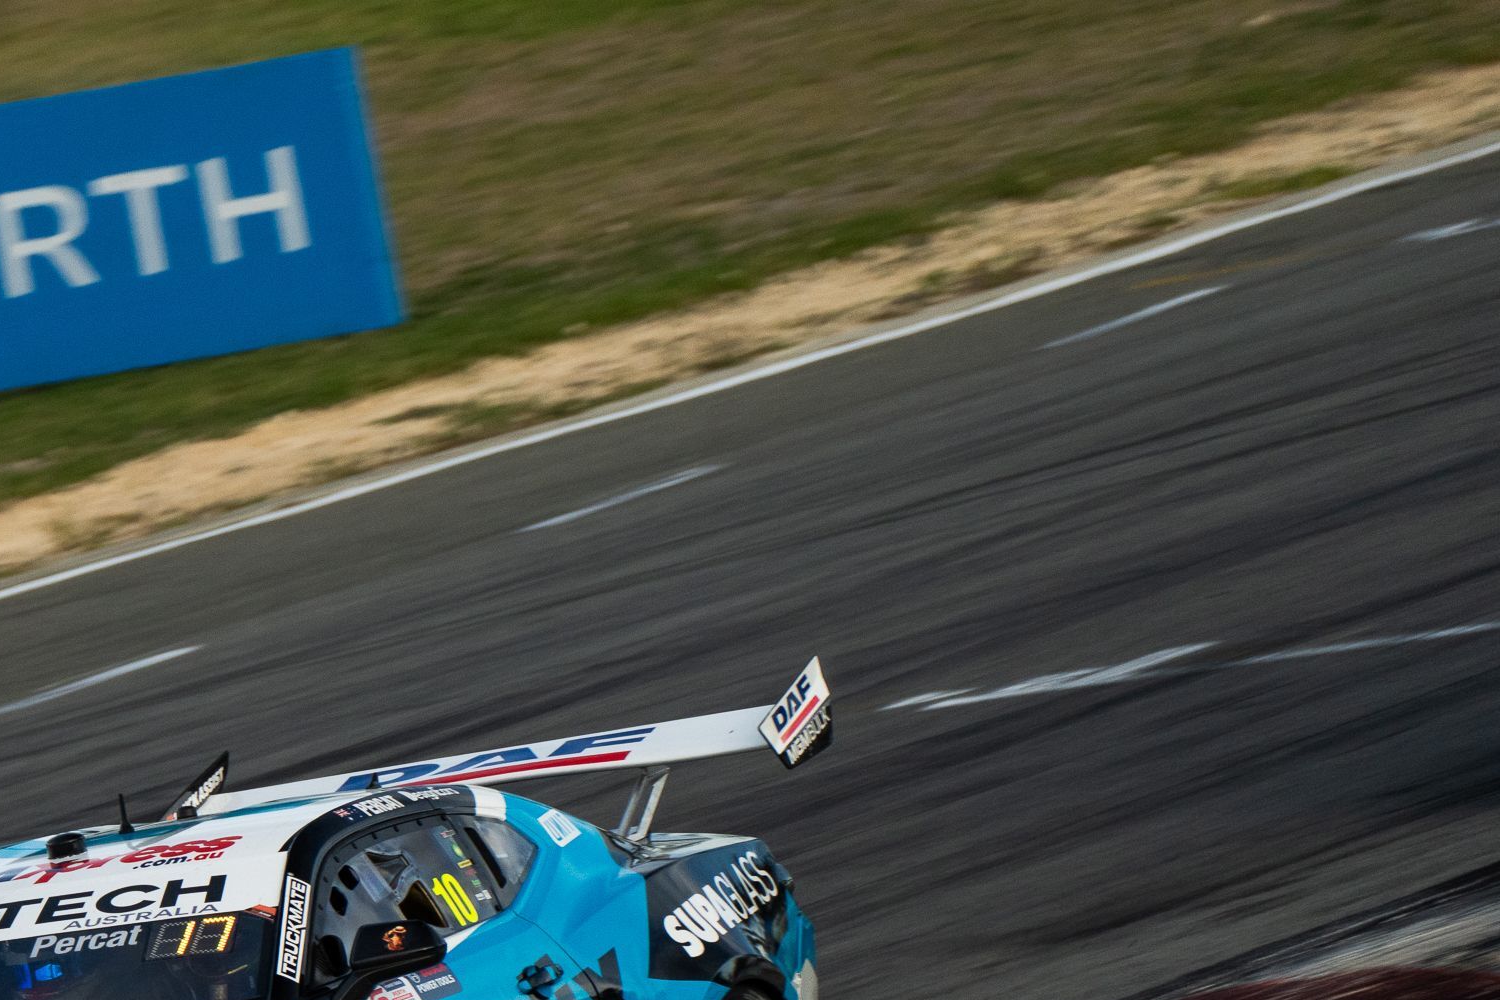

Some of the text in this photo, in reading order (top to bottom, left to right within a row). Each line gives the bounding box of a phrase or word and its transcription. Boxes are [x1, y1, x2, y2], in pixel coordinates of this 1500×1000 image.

[771, 673, 812, 734] DAF
[338, 726, 657, 793] DAF
[352, 794, 405, 817] PERCAT
[132, 850, 225, 871] .com.au
[62, 902, 219, 931] AUSTRALIA
[432, 872, 479, 927] 10
[663, 850, 779, 958] SUPAGLASS
[29, 922, 143, 959] Percat
[281, 880, 307, 976] TRUCKMATE
